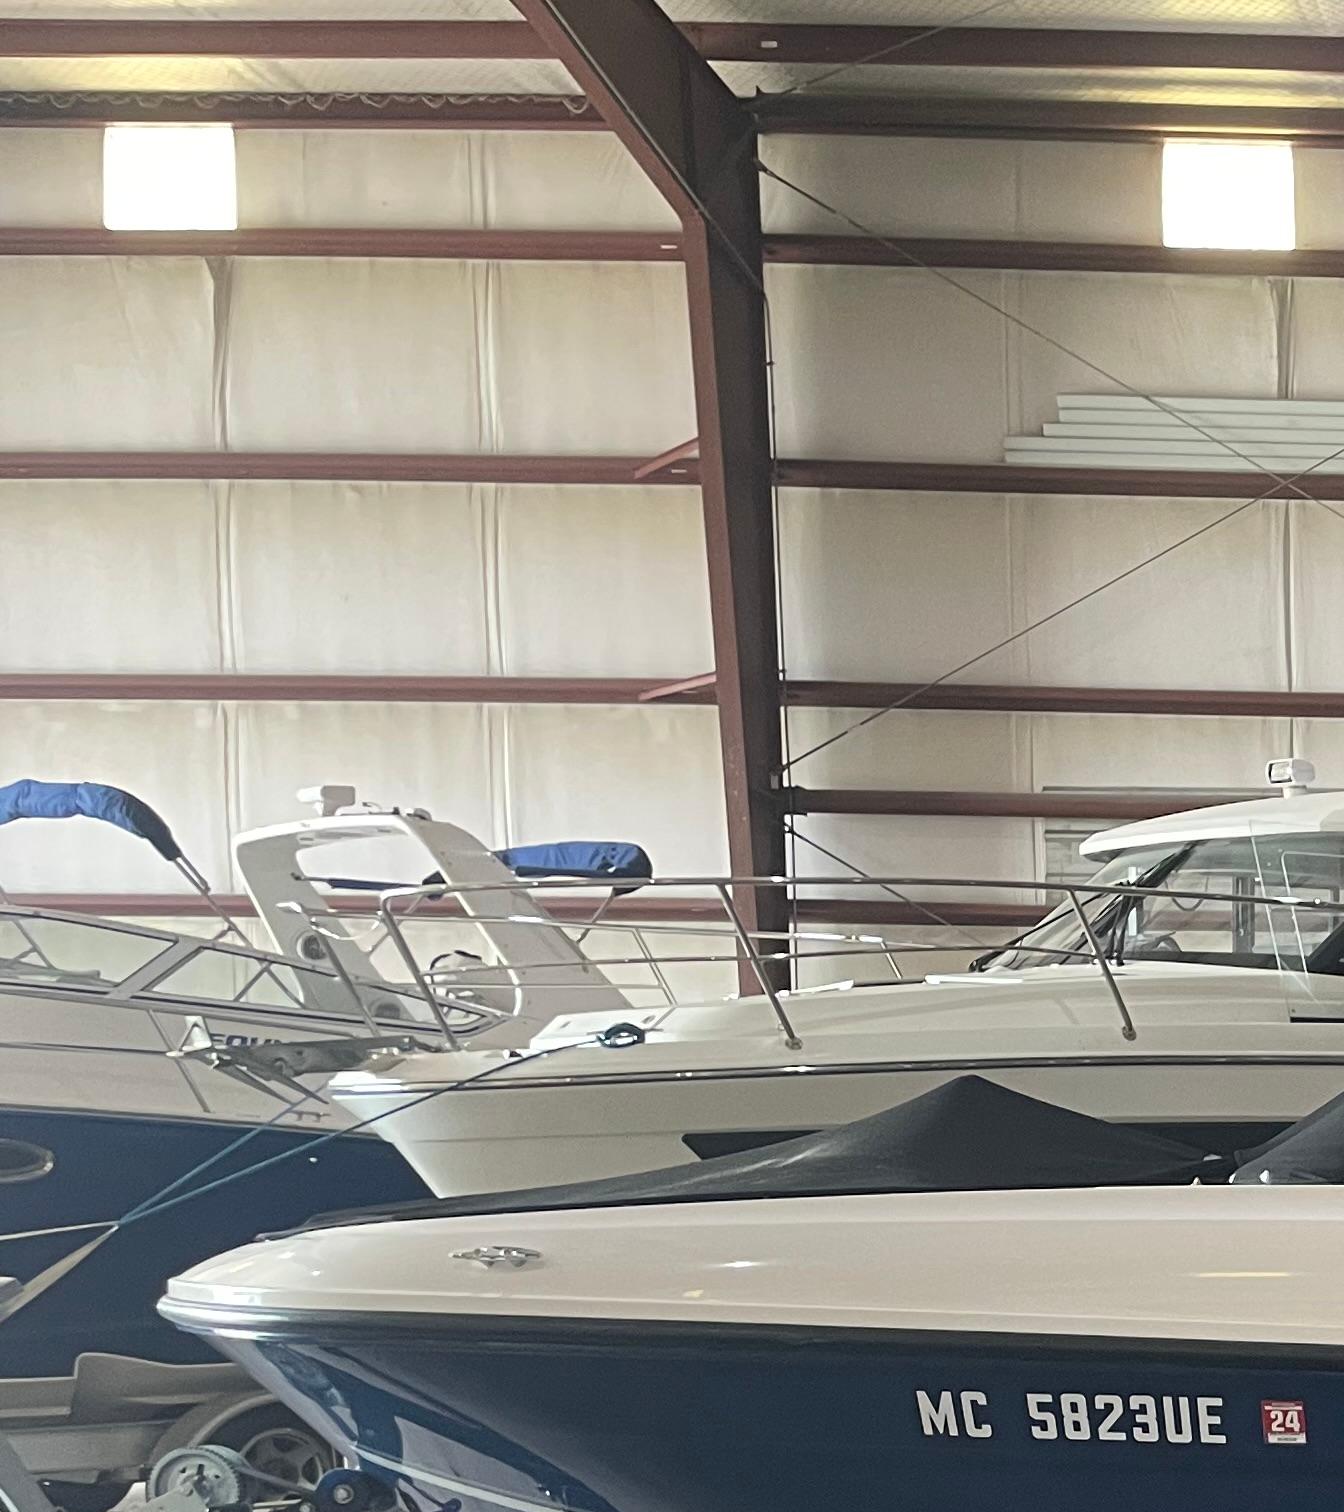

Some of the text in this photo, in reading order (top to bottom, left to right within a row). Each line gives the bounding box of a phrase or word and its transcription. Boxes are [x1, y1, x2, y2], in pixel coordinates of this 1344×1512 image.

[916, 1389, 1227, 1445] MC 5823UE
[1270, 1410, 1300, 1432] 24
